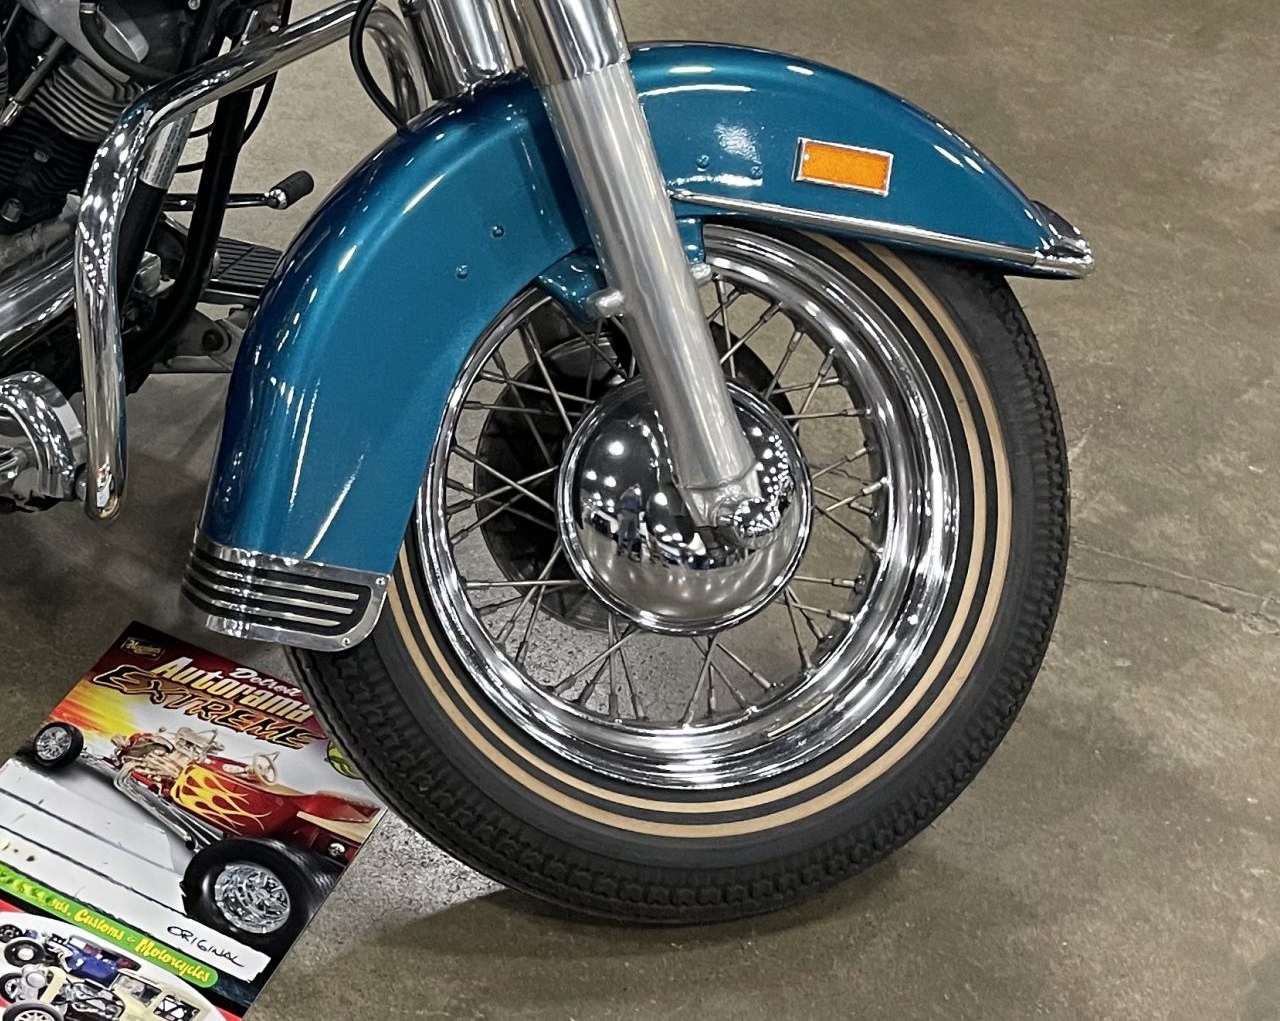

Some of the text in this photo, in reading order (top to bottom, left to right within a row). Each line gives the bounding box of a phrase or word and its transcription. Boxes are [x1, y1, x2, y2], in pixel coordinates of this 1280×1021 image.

[91, 664, 327, 750] EXTREME
[151, 656, 315, 724] Autorama
[74, 909, 123, 942] Customs
[134, 938, 211, 983] Motorcycles
[166, 926, 245, 967] ORIGINAL
